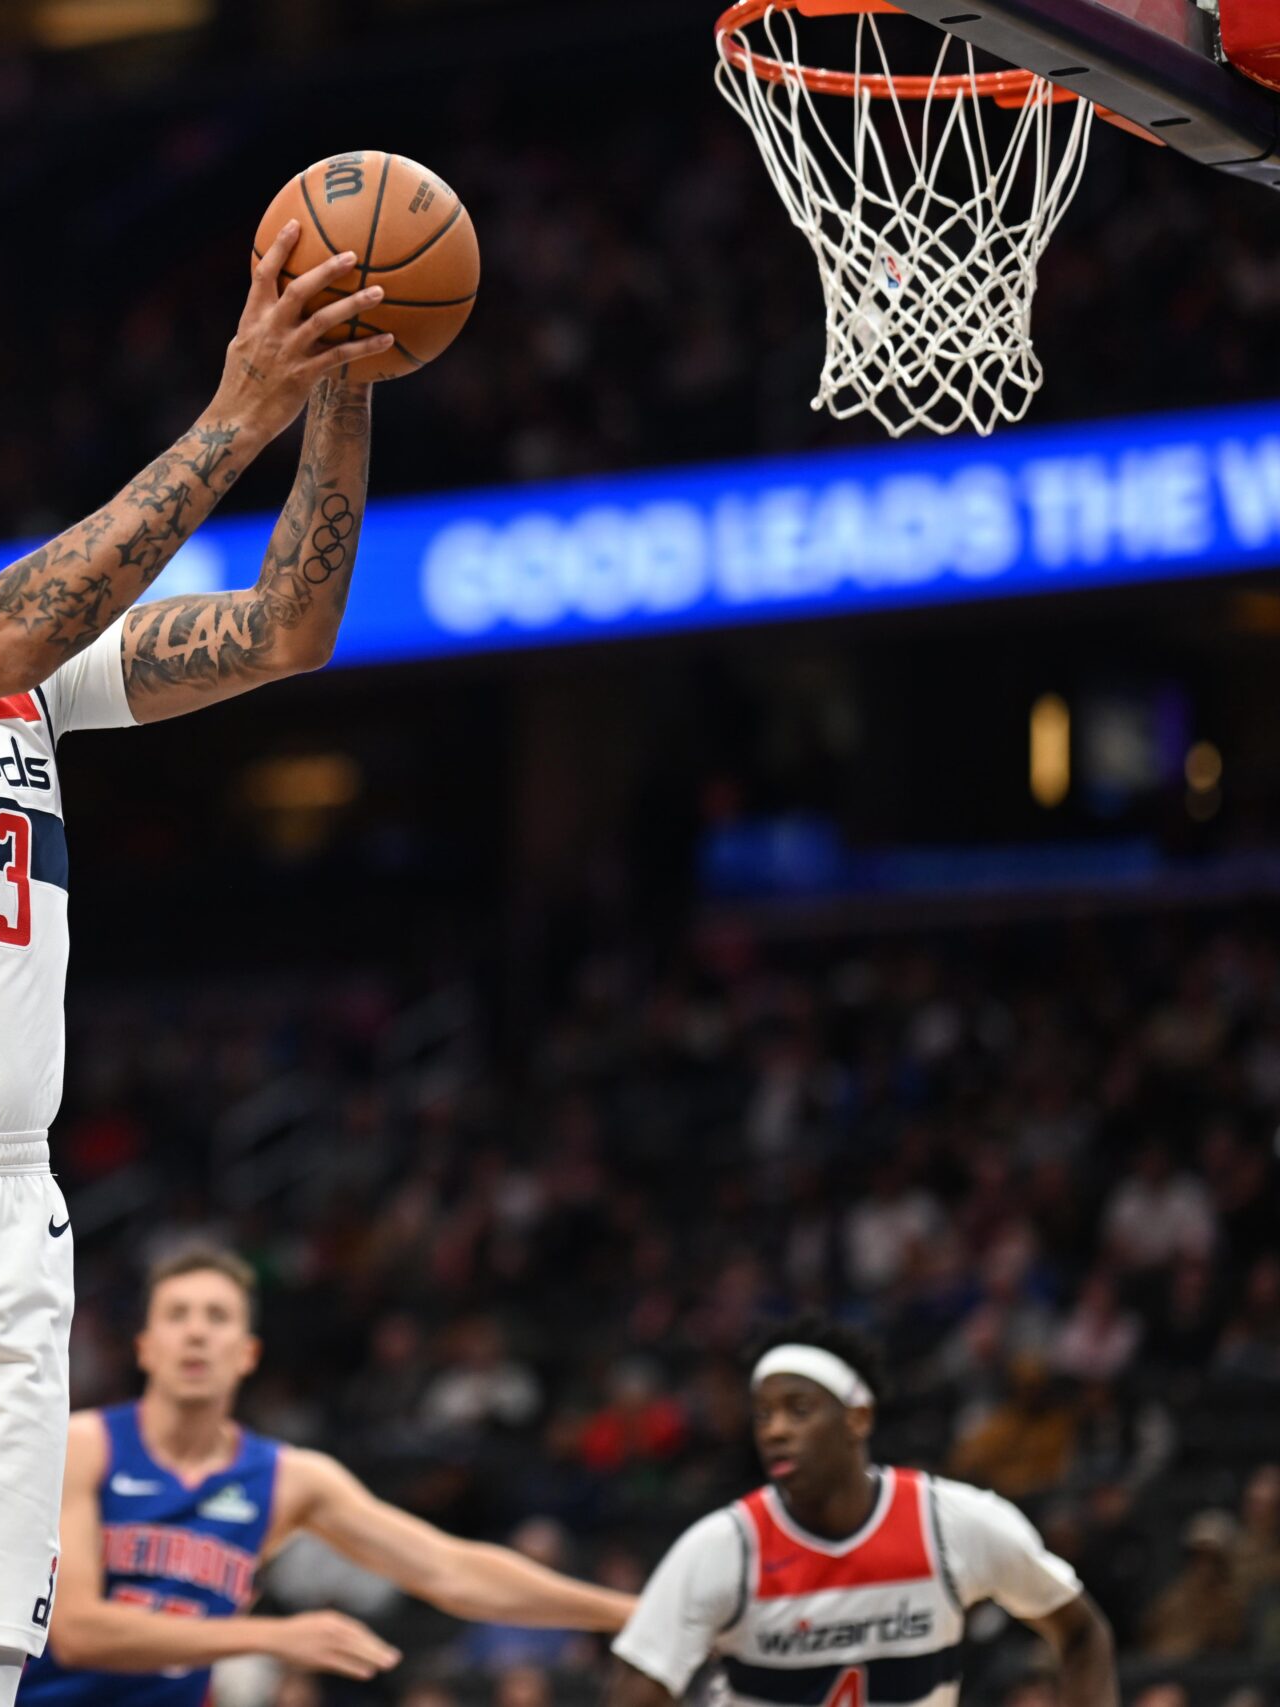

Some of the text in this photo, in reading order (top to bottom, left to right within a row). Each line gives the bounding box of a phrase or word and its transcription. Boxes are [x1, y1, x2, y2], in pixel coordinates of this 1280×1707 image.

[424, 506, 706, 631] GOOD
[715, 470, 1018, 600] LEADS
[1024, 449, 1210, 565] THE
[756, 1597, 934, 1655] wizards
